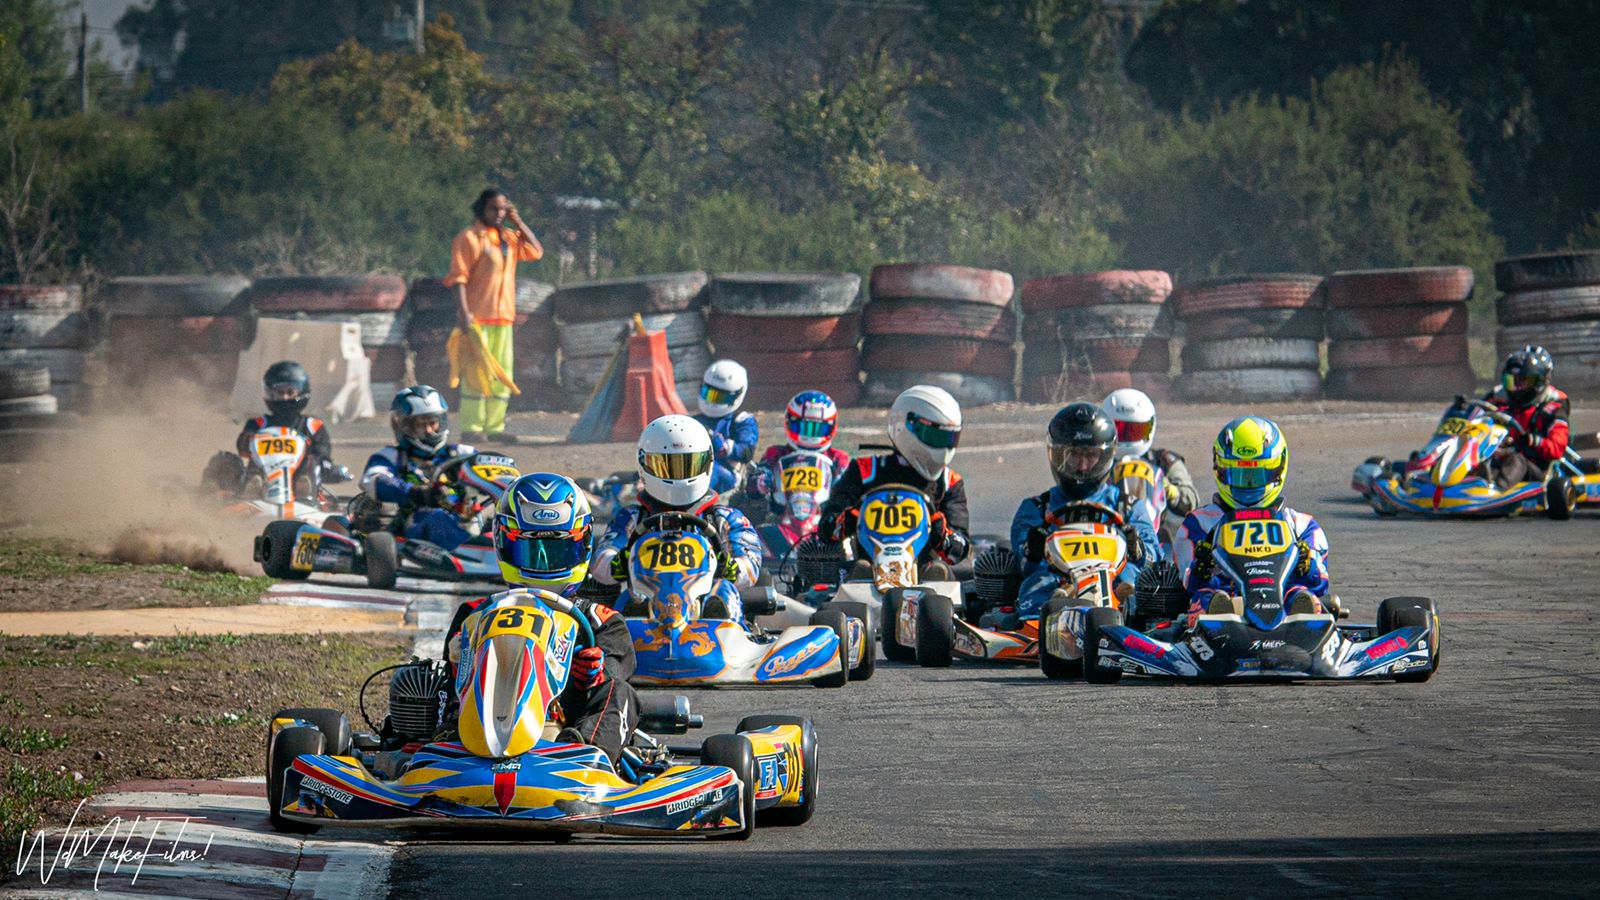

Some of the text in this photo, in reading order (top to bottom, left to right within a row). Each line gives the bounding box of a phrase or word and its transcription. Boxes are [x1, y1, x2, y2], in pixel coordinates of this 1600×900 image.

[261, 438, 295, 456] 795
[784, 468, 818, 489] 728
[871, 505, 917, 530] 705
[1231, 522, 1285, 548] 720
[646, 542, 696, 569] 788
[1064, 541, 1099, 557] 711
[301, 775, 353, 804] BRIDGESTONE
